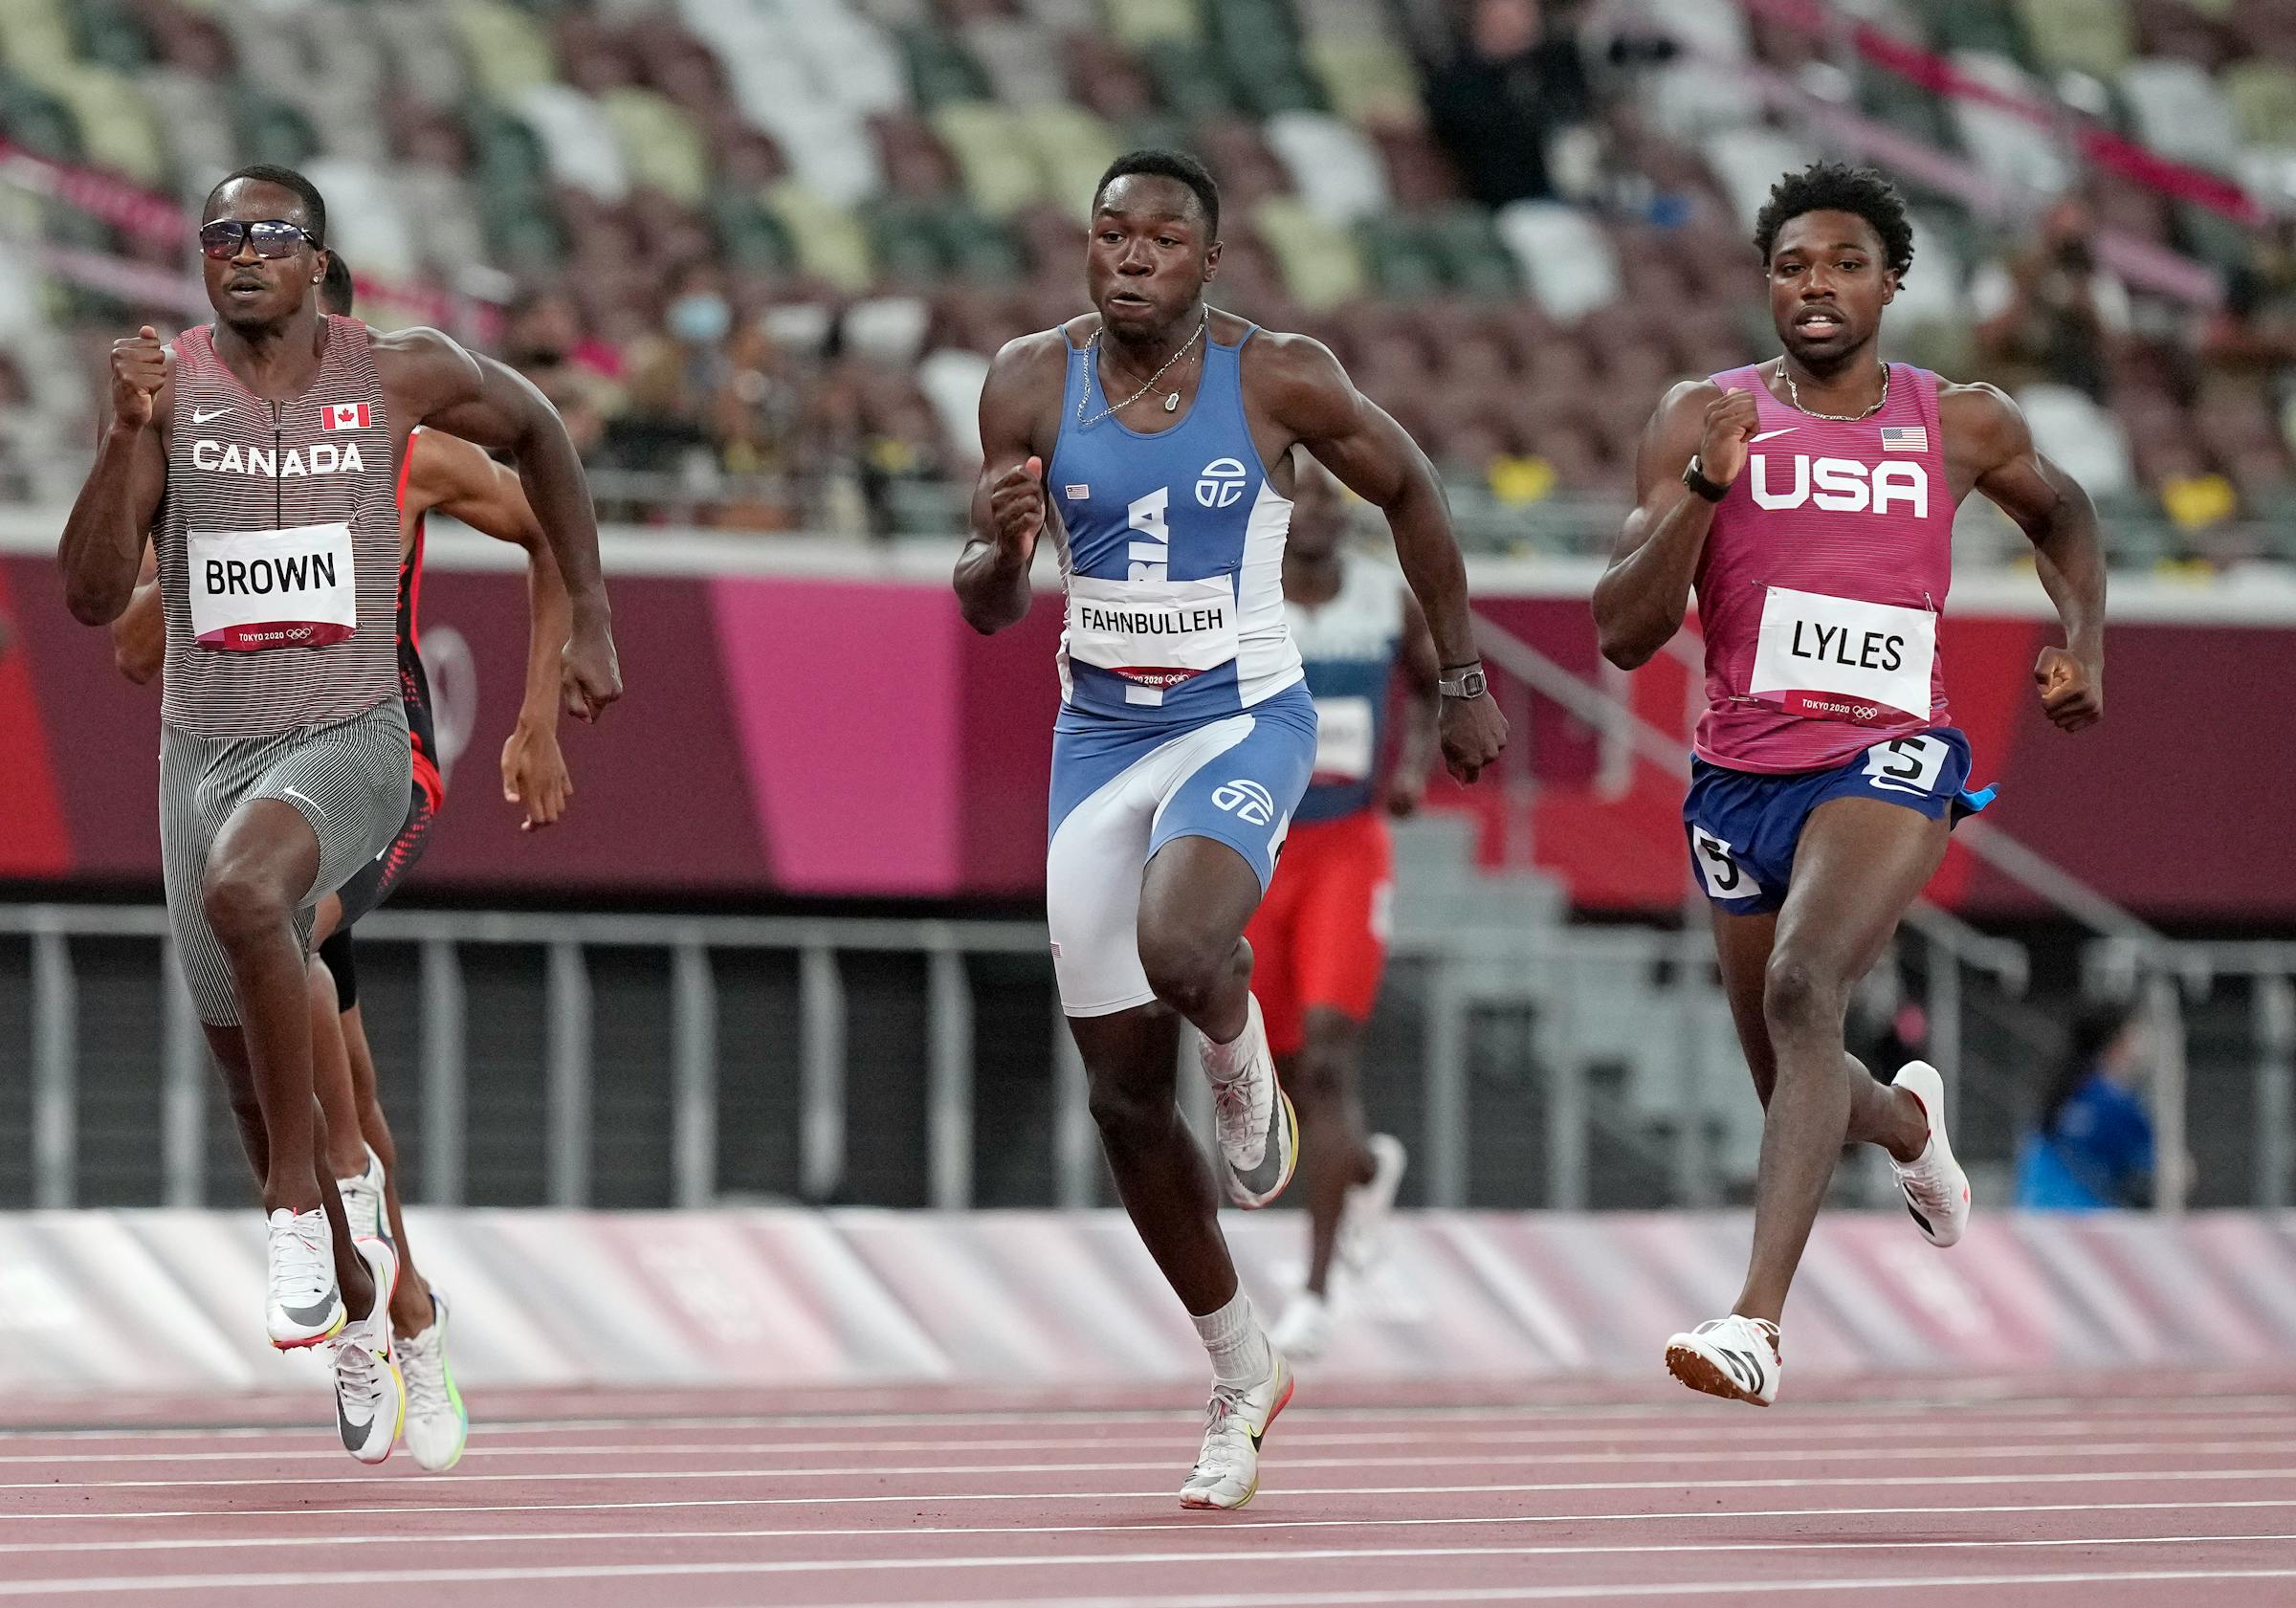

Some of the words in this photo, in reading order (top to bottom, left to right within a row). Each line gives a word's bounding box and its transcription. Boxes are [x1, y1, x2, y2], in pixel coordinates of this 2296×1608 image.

[193, 440, 364, 478] CANADA
[1750, 453, 1929, 518] USA
[206, 552, 337, 595] BROWN
[239, 632, 264, 642] TOKYO
[264, 631, 285, 640] 2020
[1081, 607, 1224, 635] FAHNBULLEH
[1791, 620, 1905, 672] LYLES
[1144, 675, 1163, 685] 2020
[1802, 698, 1829, 711] TOKYO
[1829, 703, 1850, 714] 2020
[1882, 737, 1928, 781] 5
[1699, 836, 1741, 892] 5
